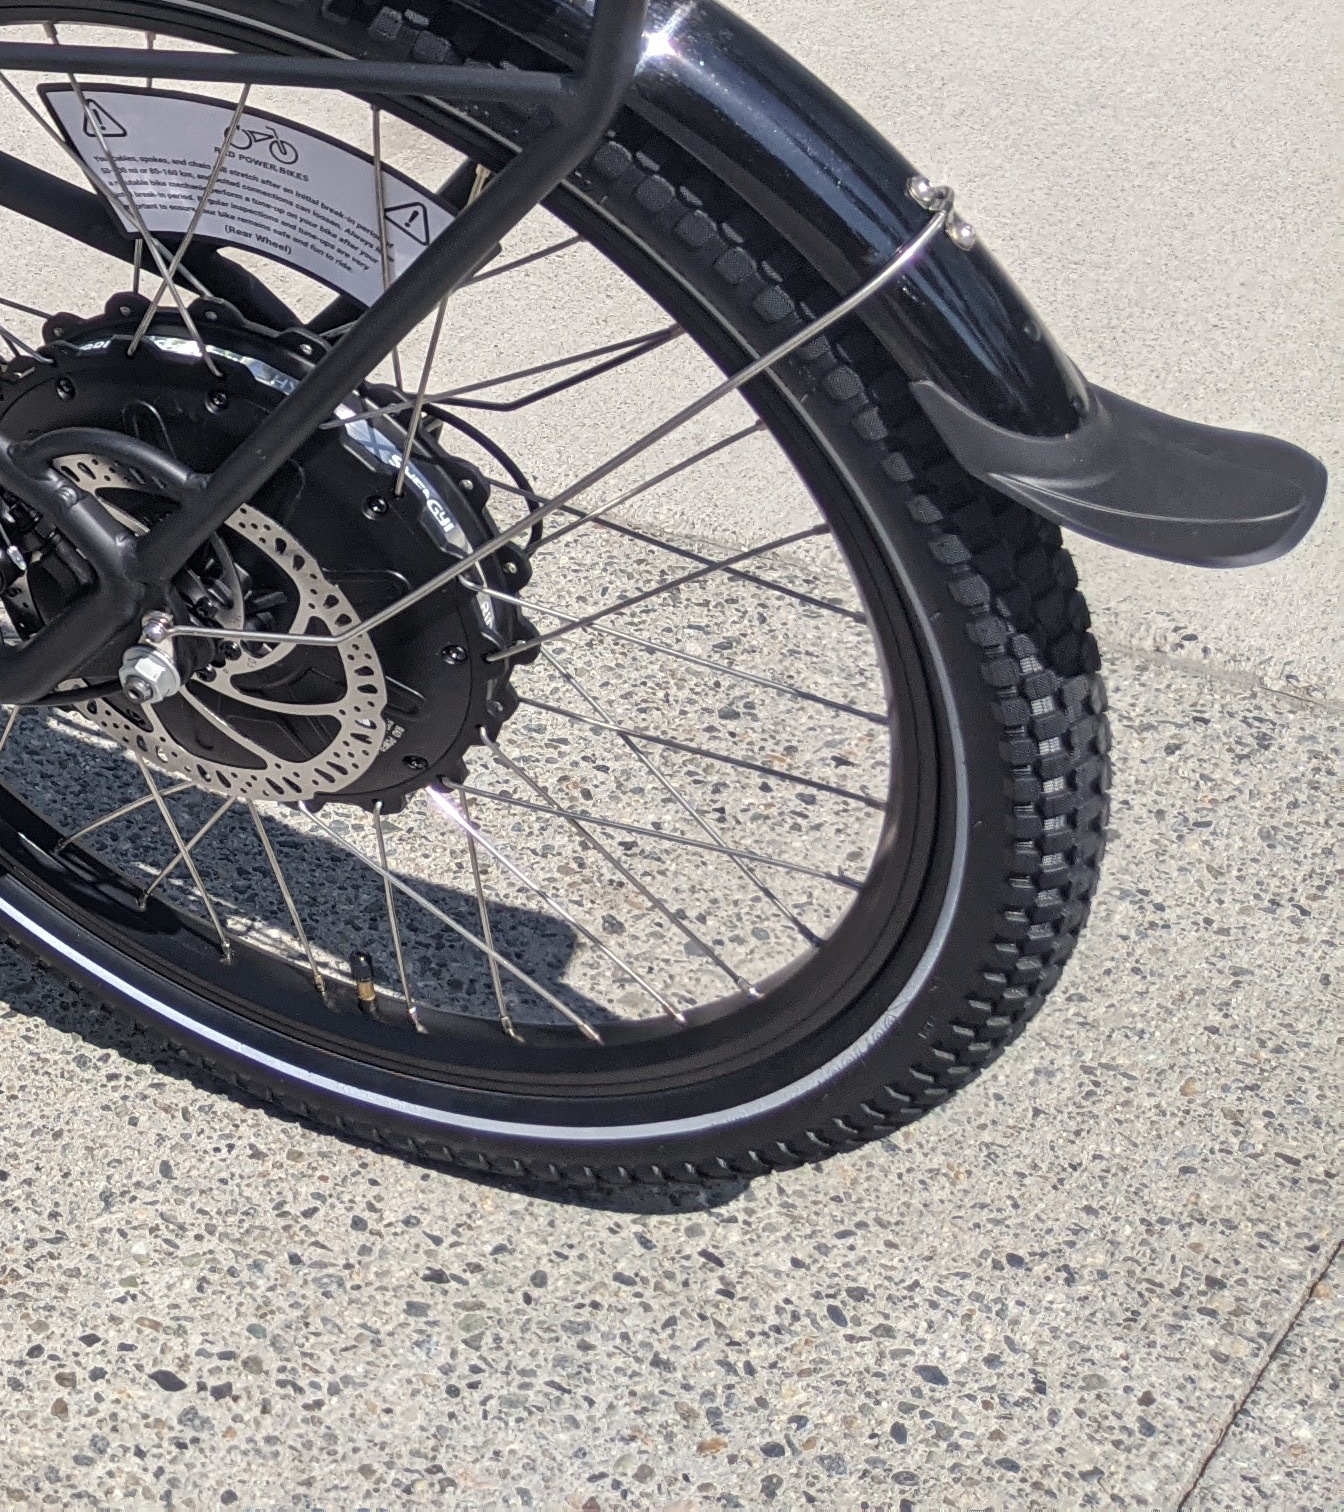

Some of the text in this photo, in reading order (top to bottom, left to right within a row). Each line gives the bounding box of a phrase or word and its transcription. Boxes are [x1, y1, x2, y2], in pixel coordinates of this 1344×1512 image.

[238, 153, 277, 171] POWER
[279, 167, 309, 182] BIKES
[261, 177, 281, 189] after
[283, 186, 294, 195] an
[321, 202, 355, 225] break-in
[224, 224, 292, 255] (Rear Wheel)
[281, 220, 297, 230] and
[336, 247, 350, 258] are
[287, 211, 298, 219] on
[319, 225, 338, 239] bike
[338, 236, 359, 251] after
[295, 203, 310, 214] can
[344, 228, 374, 249] Always
